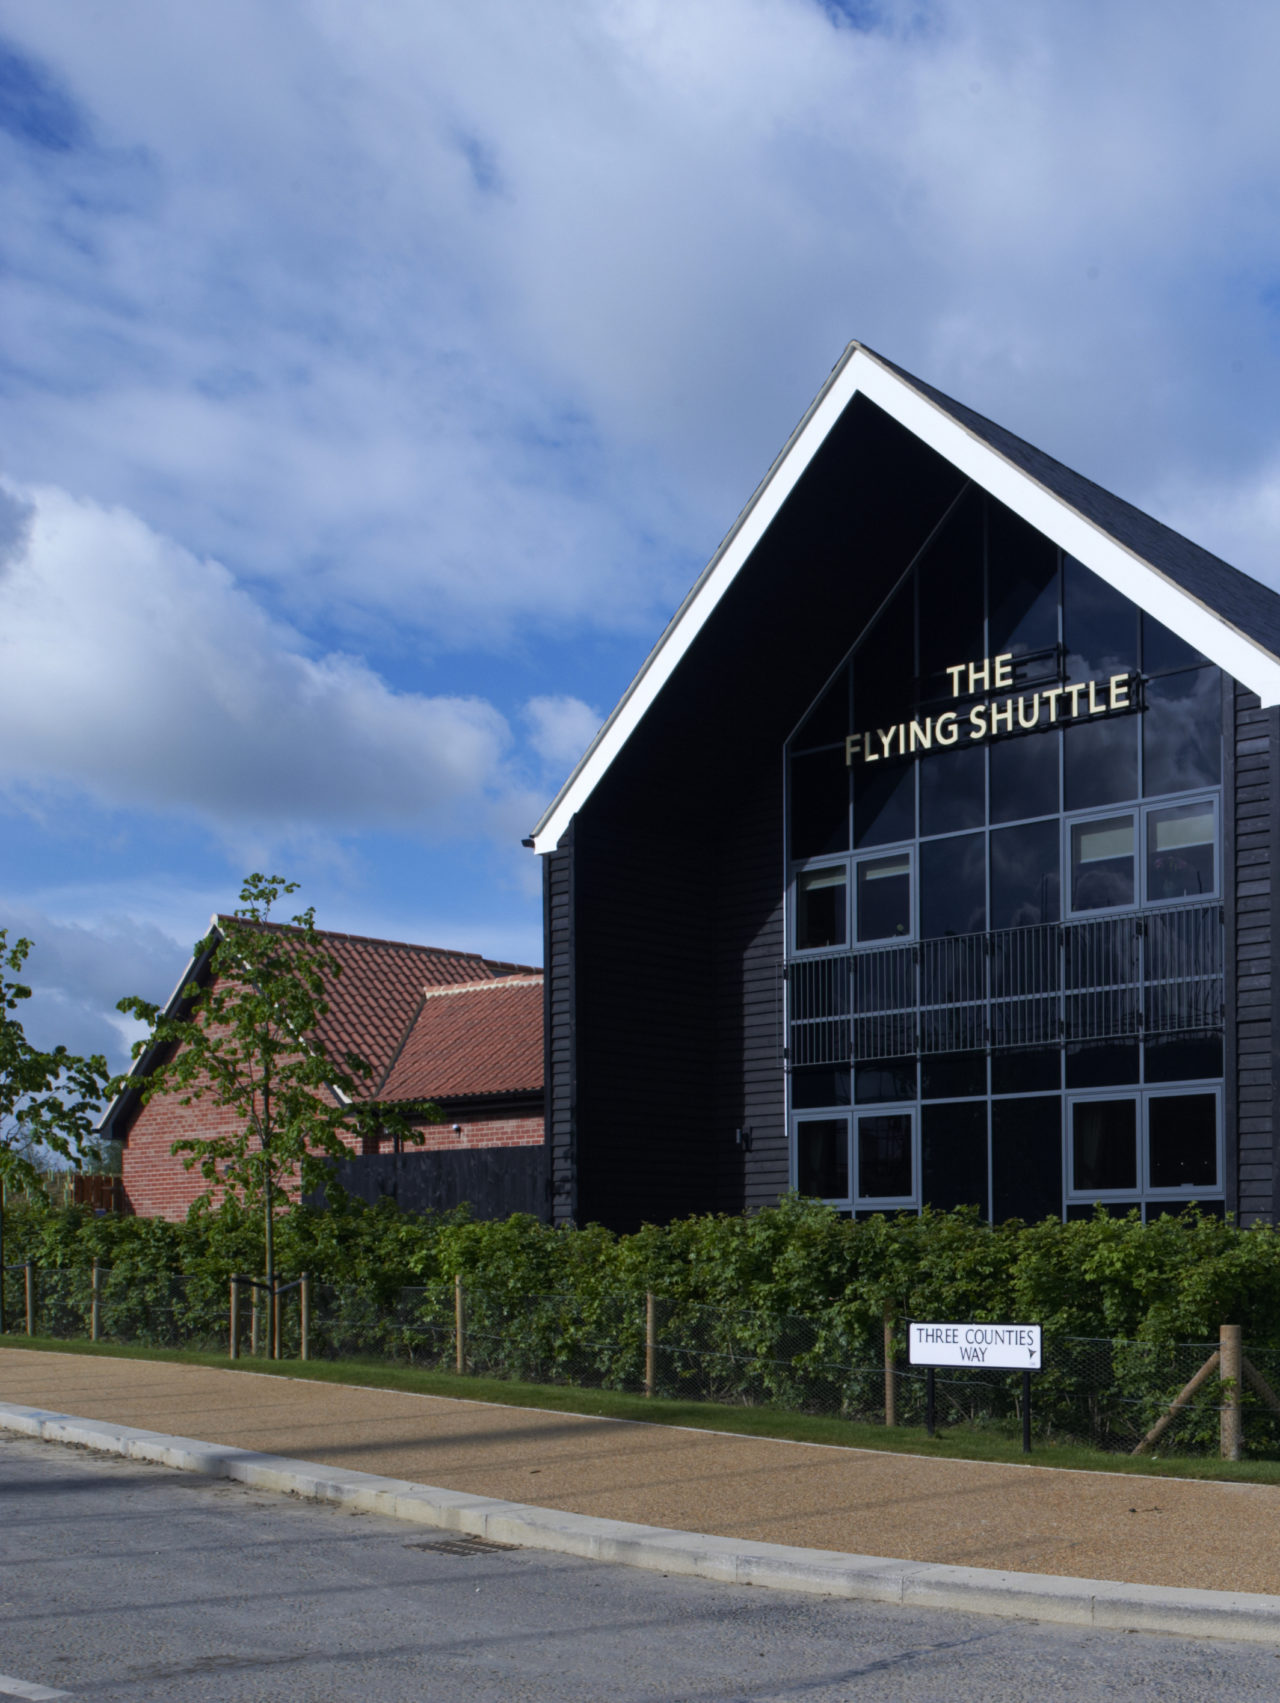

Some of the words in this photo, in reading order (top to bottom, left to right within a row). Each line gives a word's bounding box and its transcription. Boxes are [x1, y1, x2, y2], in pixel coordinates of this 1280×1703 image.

[946, 653, 1013, 698] THE
[845, 712, 958, 766] FLYING
[969, 673, 1130, 739] SHUTTLE
[917, 1328, 959, 1344] THREE
[965, 1329, 1034, 1346] COUNTIES
[960, 1347, 988, 1362] WAY
